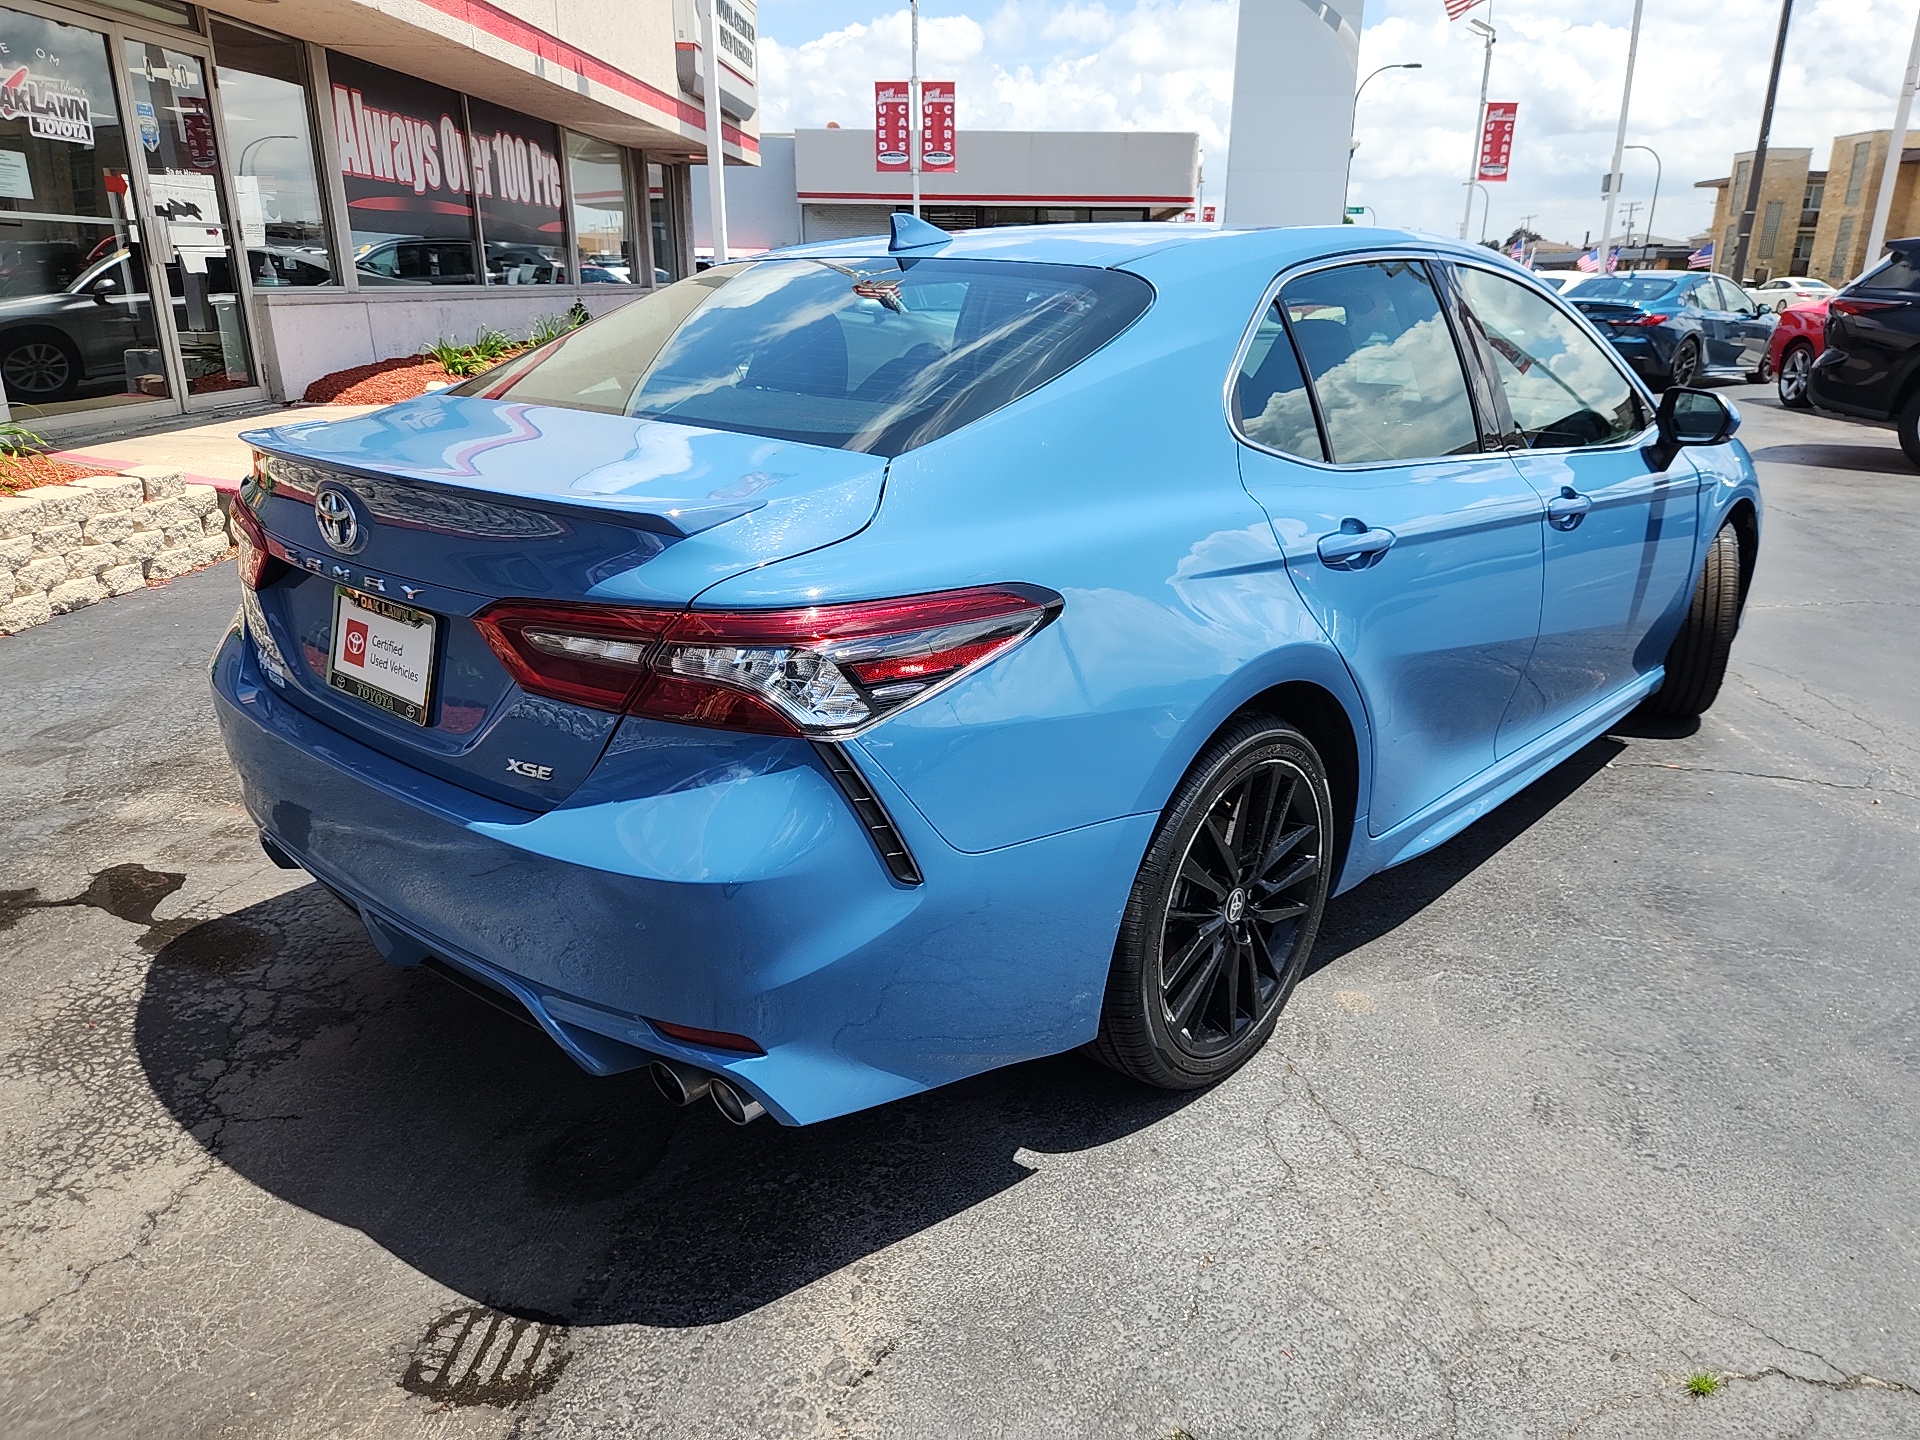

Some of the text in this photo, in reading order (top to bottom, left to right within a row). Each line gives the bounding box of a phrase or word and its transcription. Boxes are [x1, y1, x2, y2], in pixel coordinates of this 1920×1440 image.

[37, 118, 89, 139] TOYOTA
[879, 105, 888, 151] USED
[897, 105, 907, 151] CARS
[924, 105, 933, 151] USED
[943, 105, 953, 151] CARS
[1482, 122, 1495, 164] USED
[333, 83, 562, 211] Always Over 100 Pre
[361, 595, 380, 613] OAK
[371, 634, 404, 657] Certified
[369, 652, 419, 683] Used Vehicles
[356, 683, 395, 711] TOYOTA
[505, 757, 554, 781] XSE
